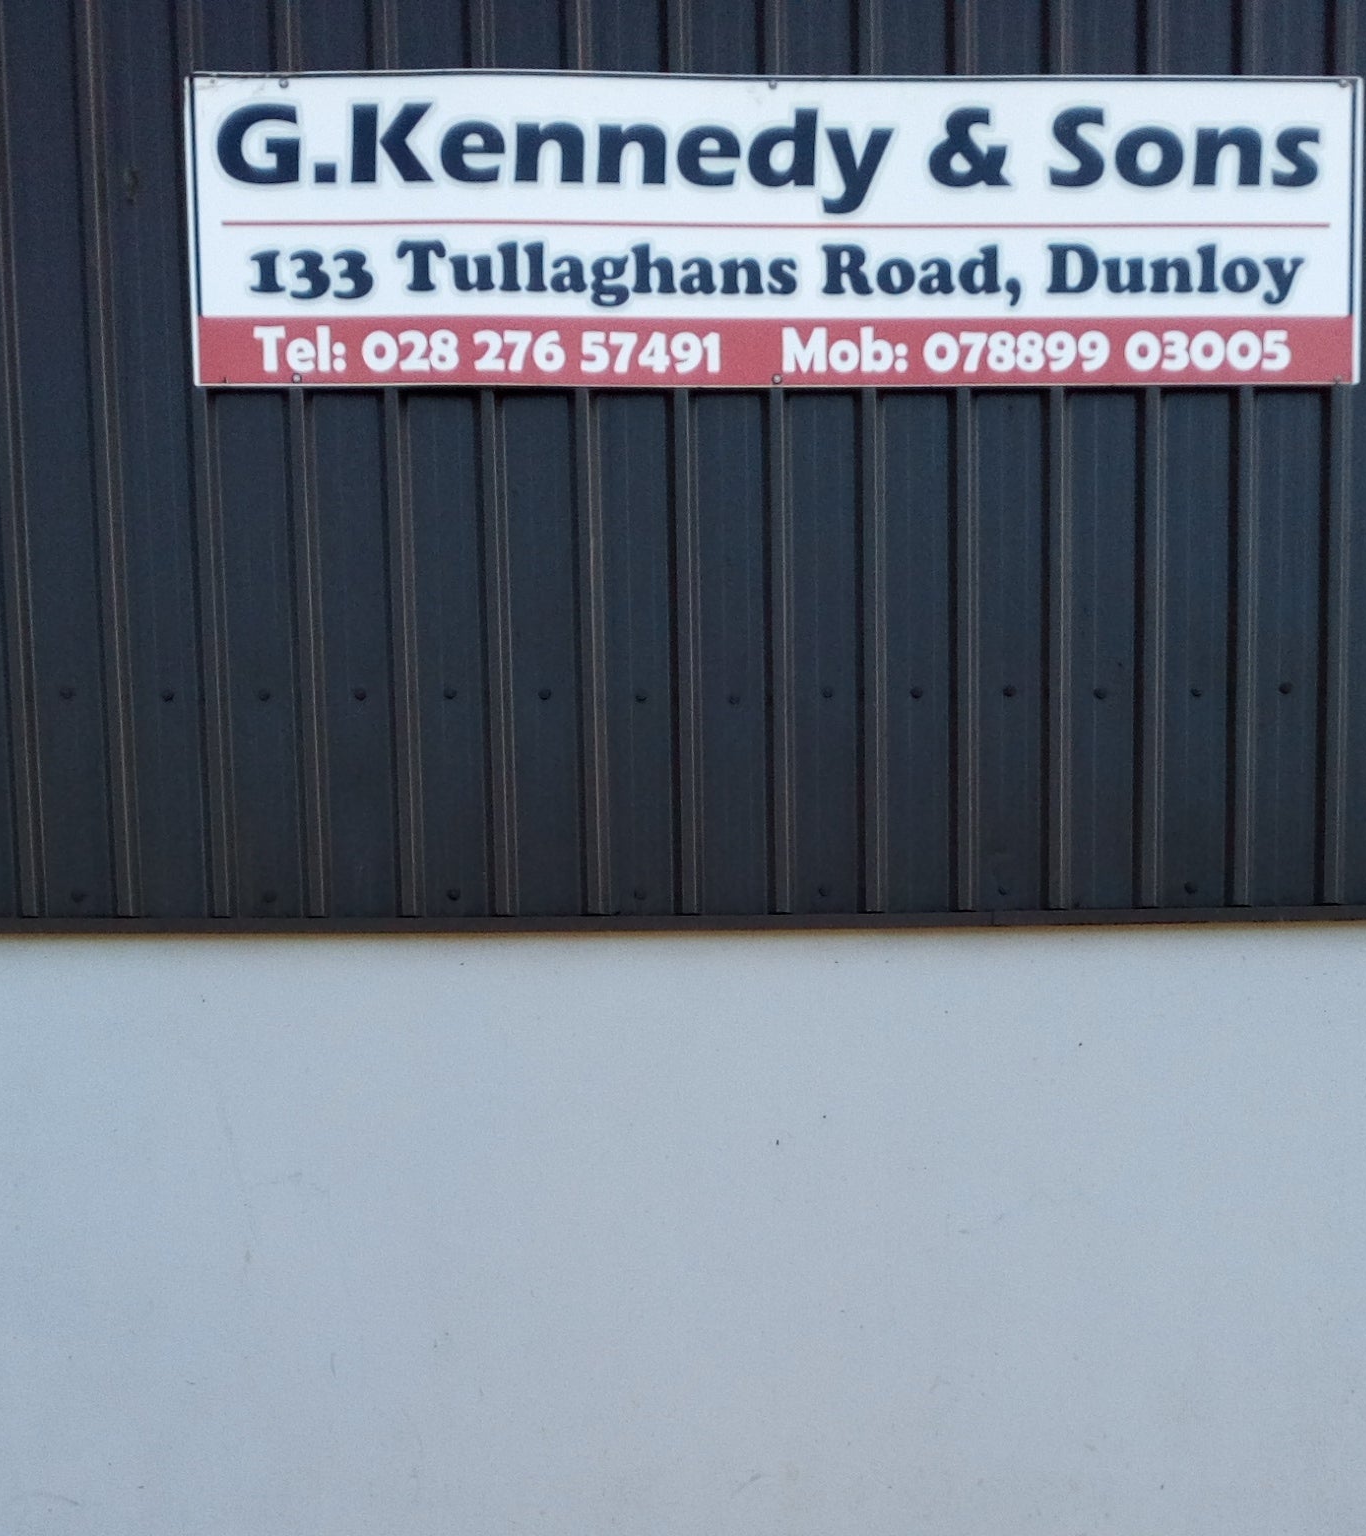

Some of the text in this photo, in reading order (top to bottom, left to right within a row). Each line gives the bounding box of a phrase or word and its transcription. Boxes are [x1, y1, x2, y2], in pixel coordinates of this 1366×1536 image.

[216, 103, 1320, 216] G.Kennedy & Sons
[250, 240, 1303, 308] 133 Tullaghans Road, Dunloy
[252, 325, 1292, 375] Tel: 028 276 57491 Mob: 078899 03005
